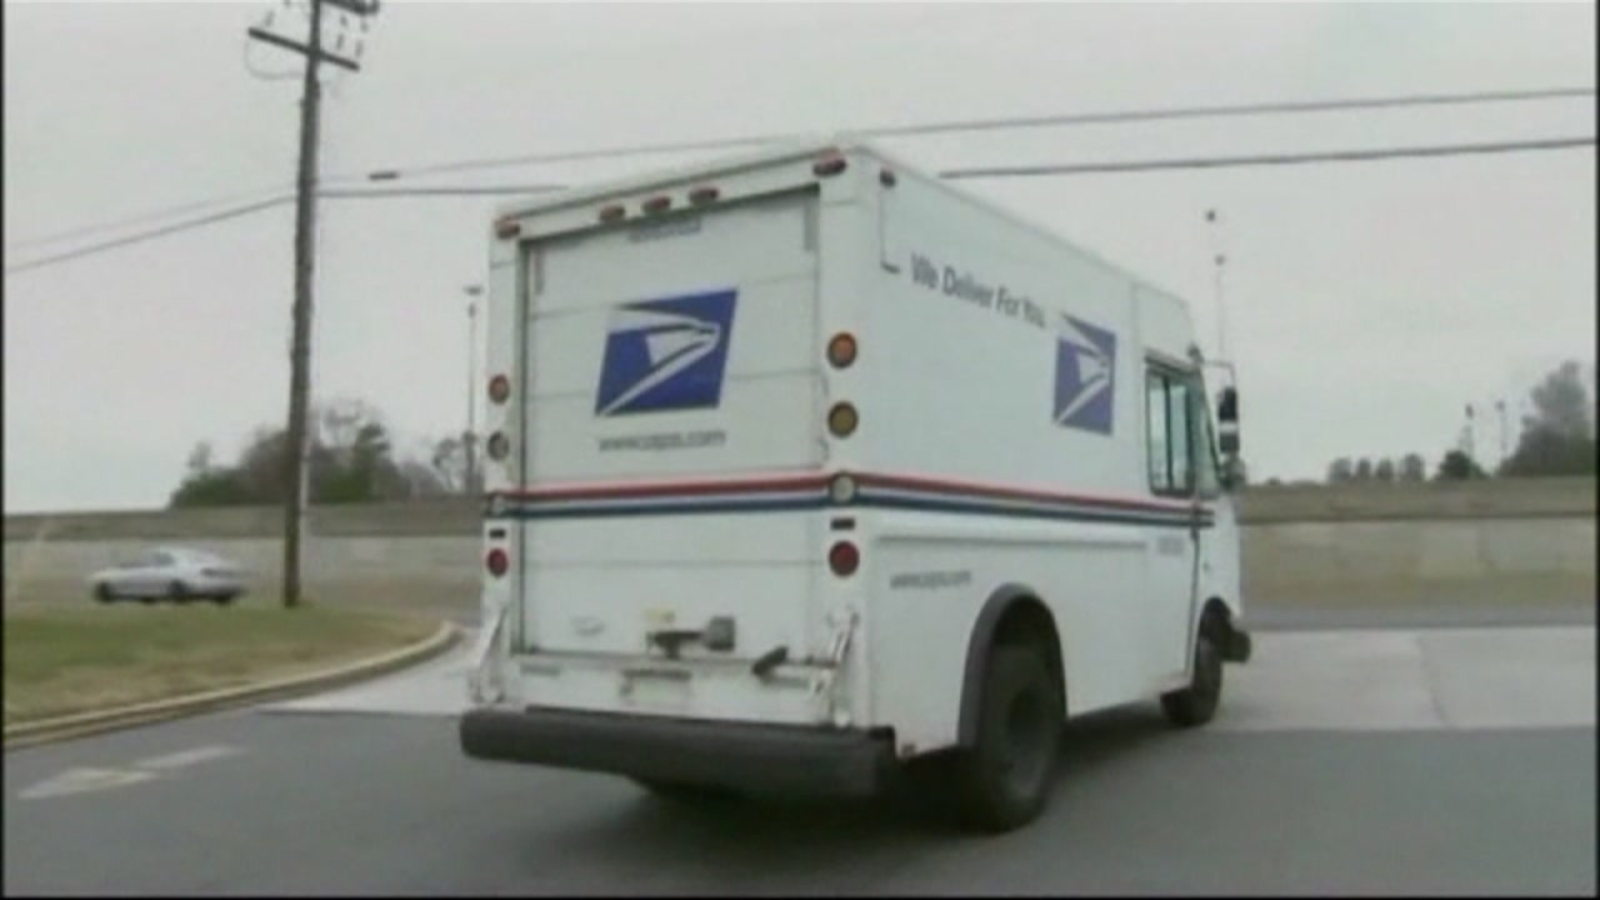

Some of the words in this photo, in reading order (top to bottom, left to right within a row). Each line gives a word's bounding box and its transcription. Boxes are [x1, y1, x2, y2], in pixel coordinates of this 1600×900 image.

[910, 252, 939, 290] We
[943, 265, 995, 309] Deliver
[996, 284, 1020, 317] For
